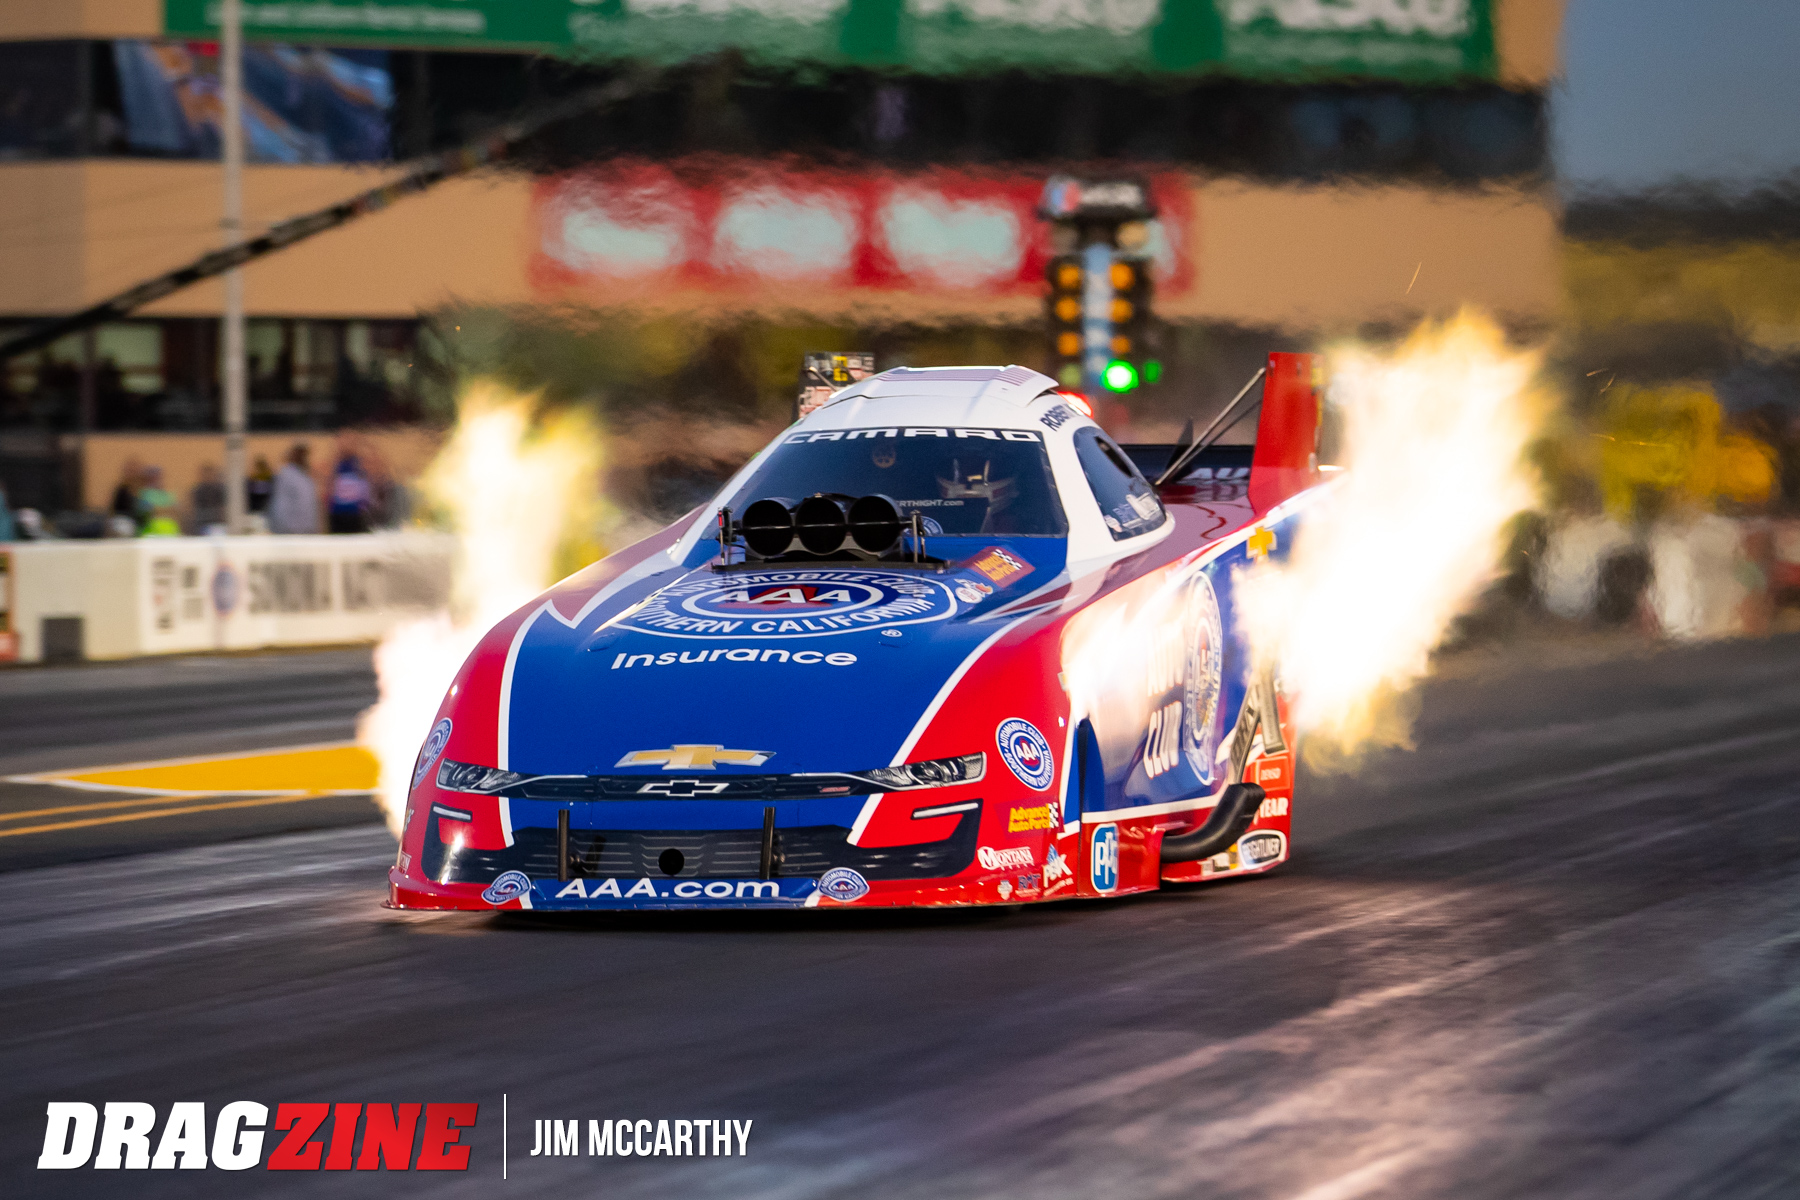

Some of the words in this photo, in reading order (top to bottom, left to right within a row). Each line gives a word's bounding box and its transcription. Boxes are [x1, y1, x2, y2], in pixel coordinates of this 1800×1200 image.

[783, 428, 1041, 442] CAMARO
[668, 573, 879, 597] AUTOMOBILE
[708, 588, 851, 605] AAA
[751, 597, 936, 633] CALIFORNIA
[611, 648, 858, 670] Insurance
[1000, 722, 1027, 748] AUTOMOBILE
[1027, 726, 1045, 746] CLUB
[1015, 743, 1039, 761] AAA
[1004, 752, 1039, 787] SOUTHERN
[1037, 750, 1052, 787] CALIFORNIA
[1010, 806, 1048, 822] Advance
[1008, 820, 1029, 833] Auto
[555, 878, 780, 899] AAA.com
